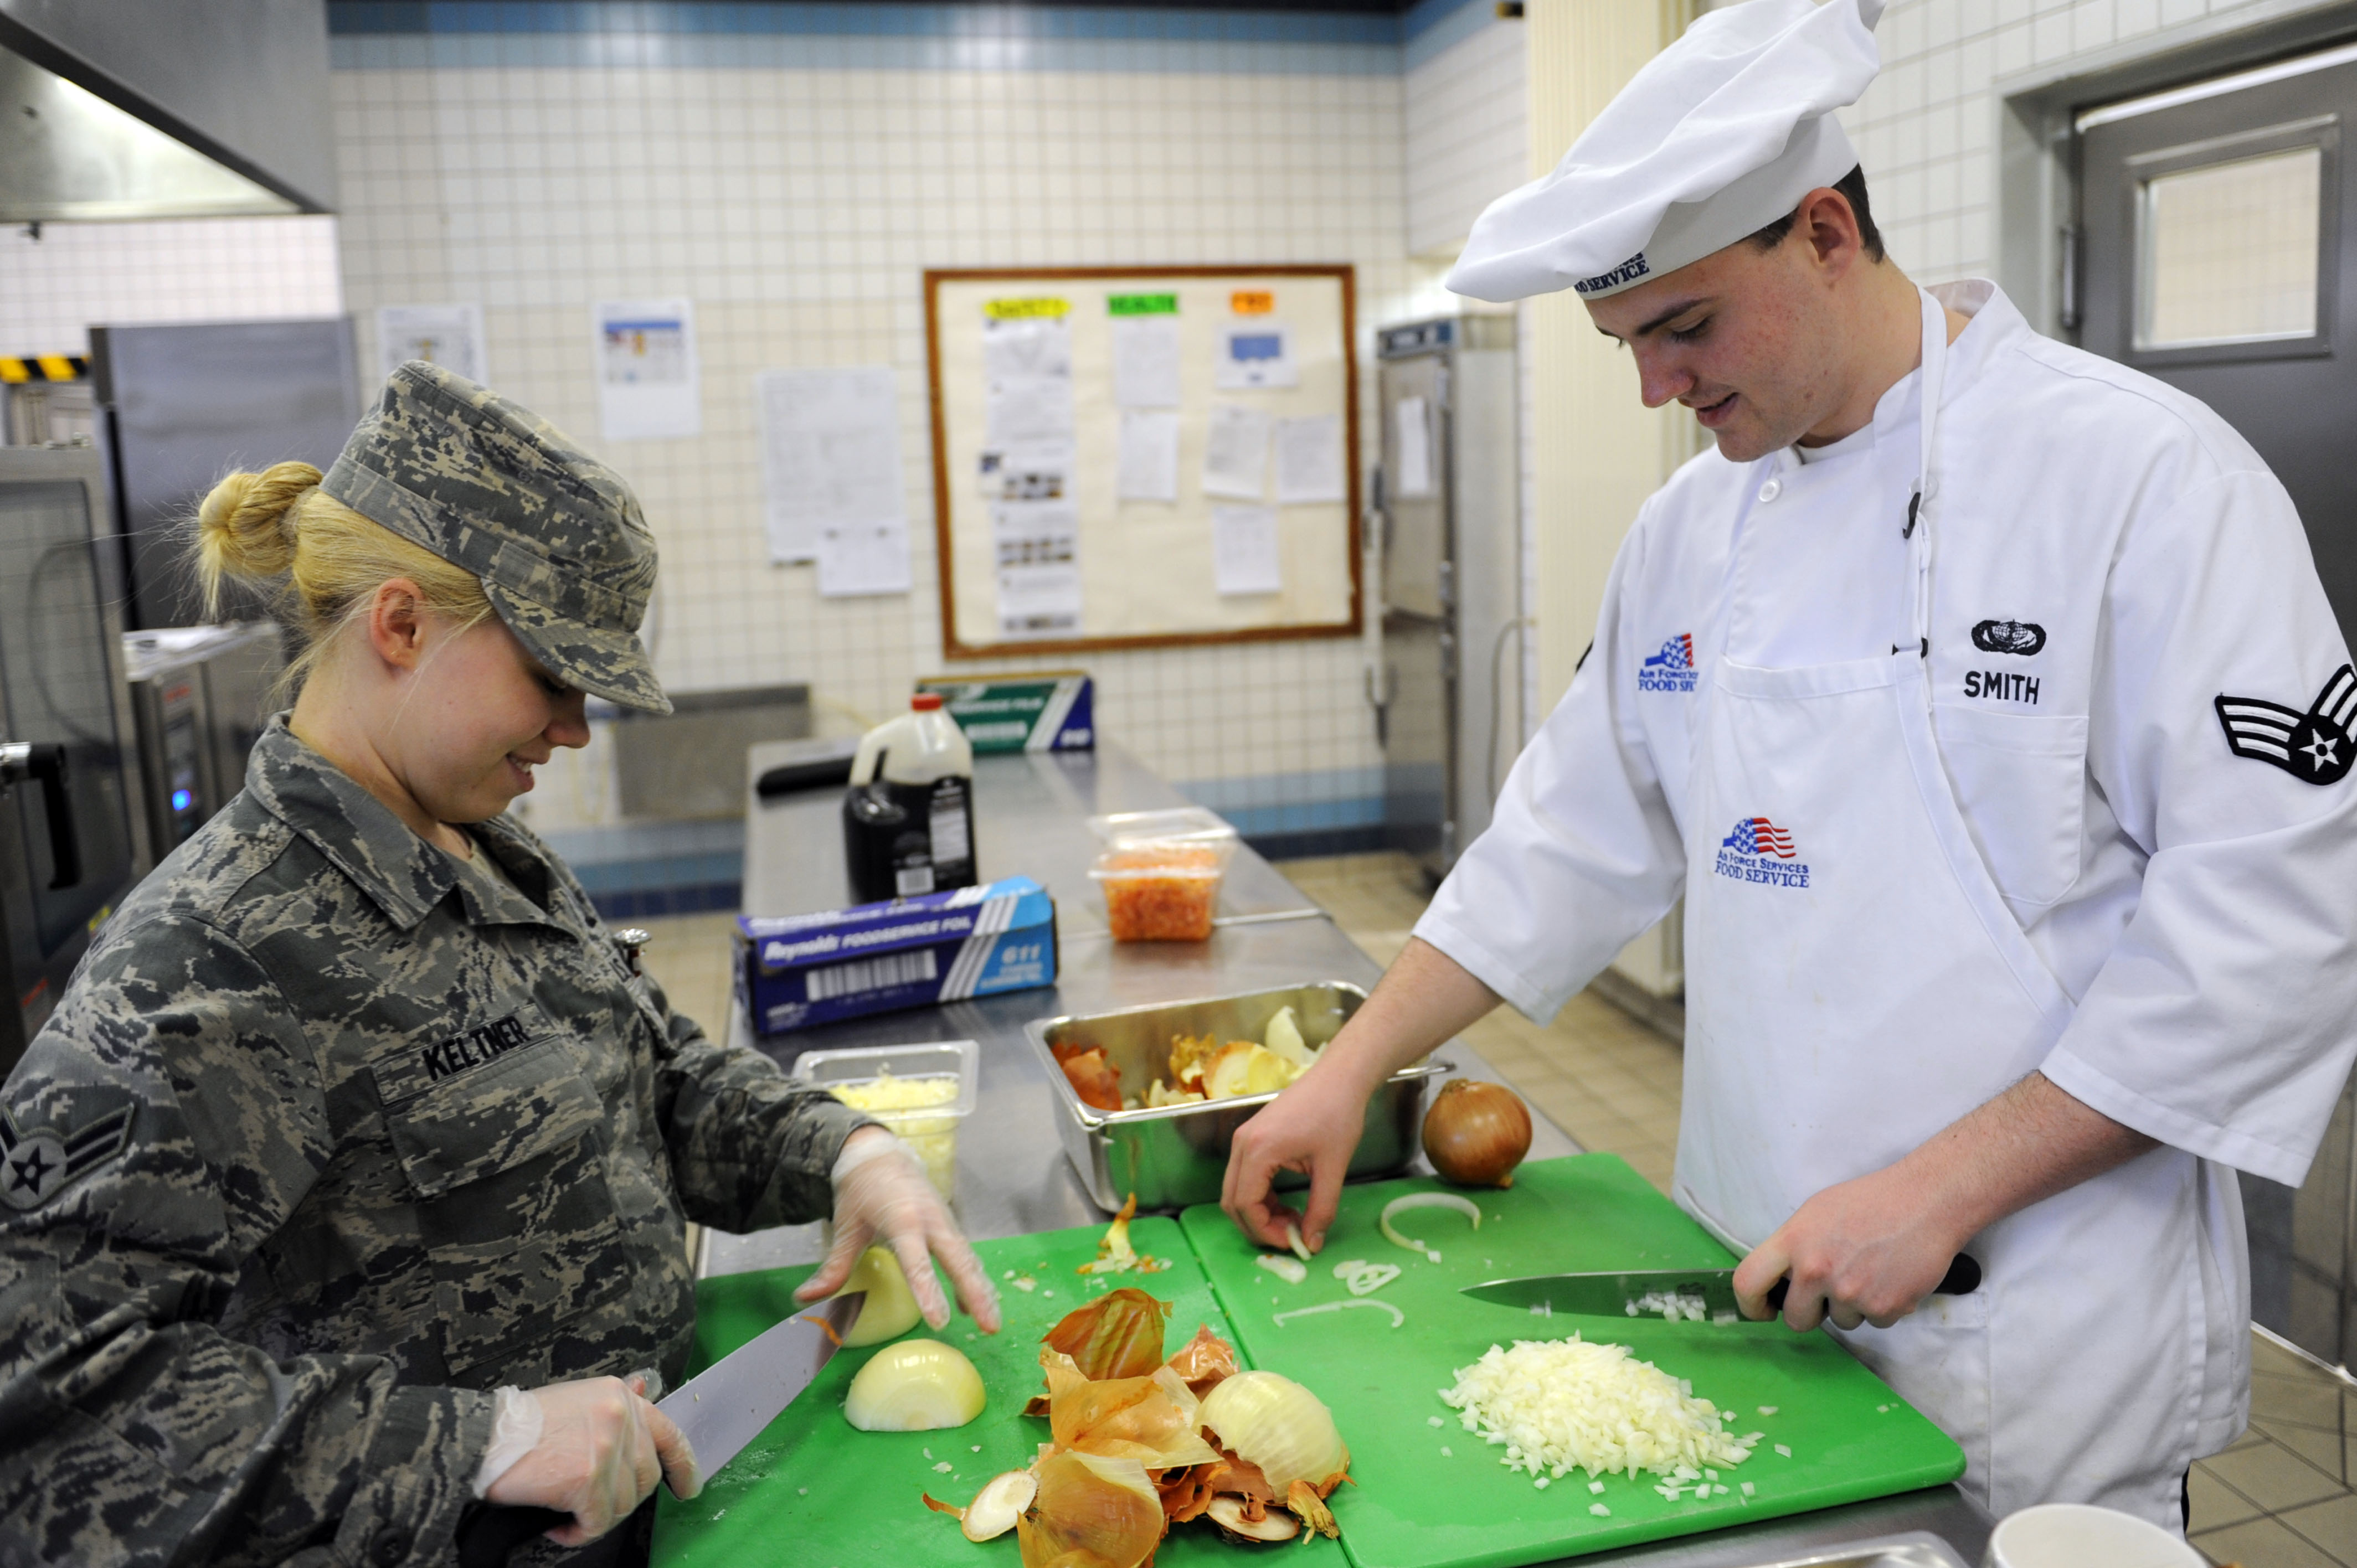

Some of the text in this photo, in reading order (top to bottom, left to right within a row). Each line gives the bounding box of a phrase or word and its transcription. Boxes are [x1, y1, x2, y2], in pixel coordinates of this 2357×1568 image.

[1587, 260, 1650, 292] SERVICE
[1639, 679, 1677, 691] FOOD
[1963, 670, 2040, 705] SMITH
[1715, 860, 1809, 888] FOOD SERVICE
[1730, 852, 1757, 868] FORCE
[1760, 858, 1809, 873] SERVICES
[764, 933, 840, 962] Reynolds
[841, 920, 940, 948] FOODSERVICE
[942, 916, 971, 931] FOIL
[422, 1015, 531, 1081] KELTNER
